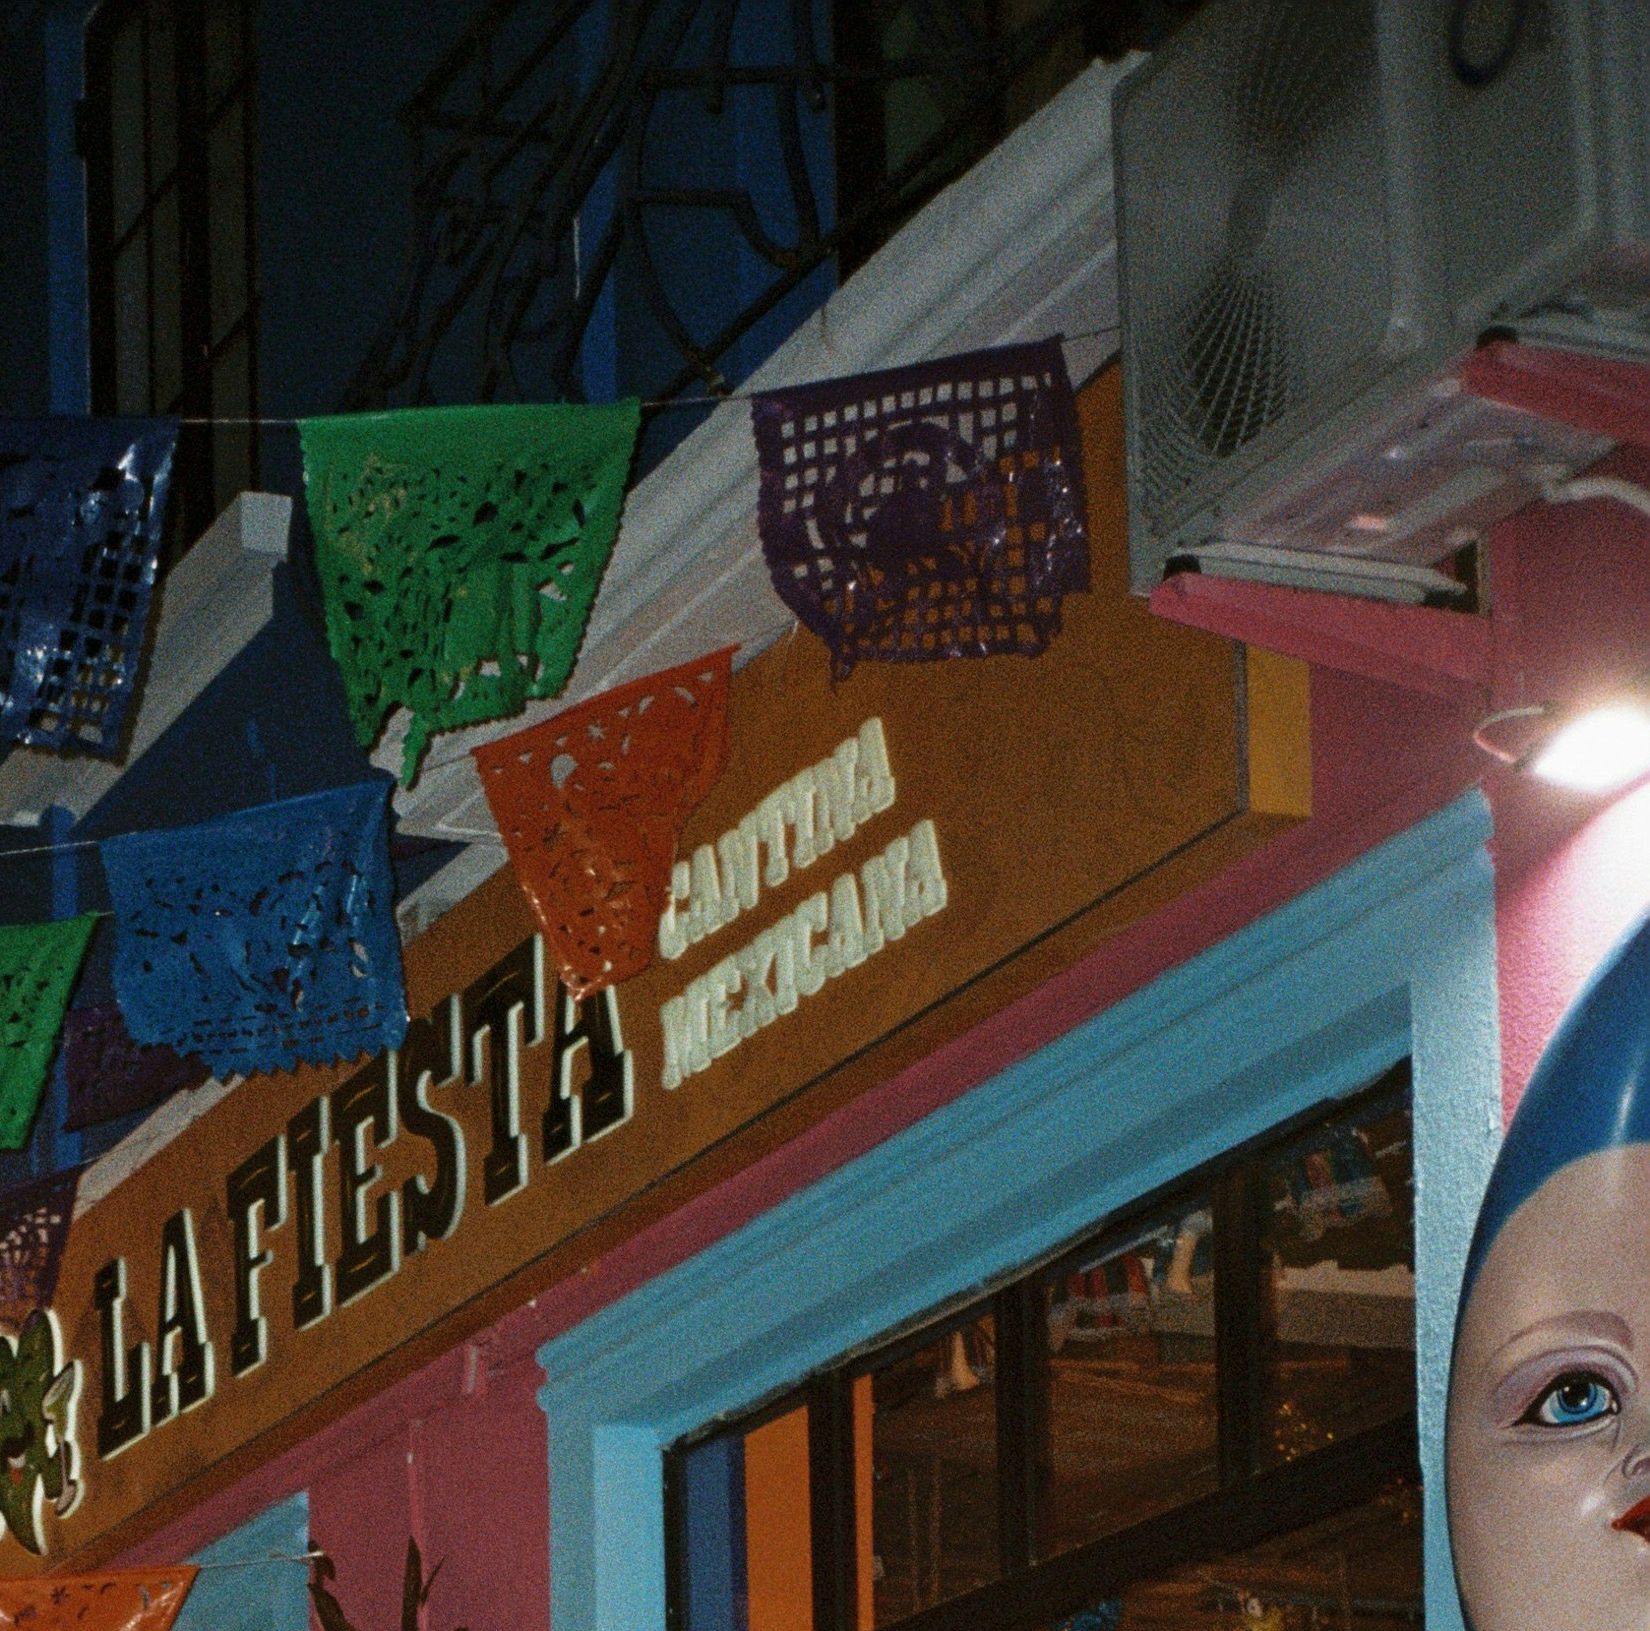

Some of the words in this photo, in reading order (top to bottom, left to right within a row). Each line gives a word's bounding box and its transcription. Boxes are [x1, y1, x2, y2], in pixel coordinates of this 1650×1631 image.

[659, 716, 896, 960] CANTINA
[660, 819, 948, 1091] MEXICANA
[94, 1207, 216, 1460] LA
[226, 935, 636, 1378] FIESTA
